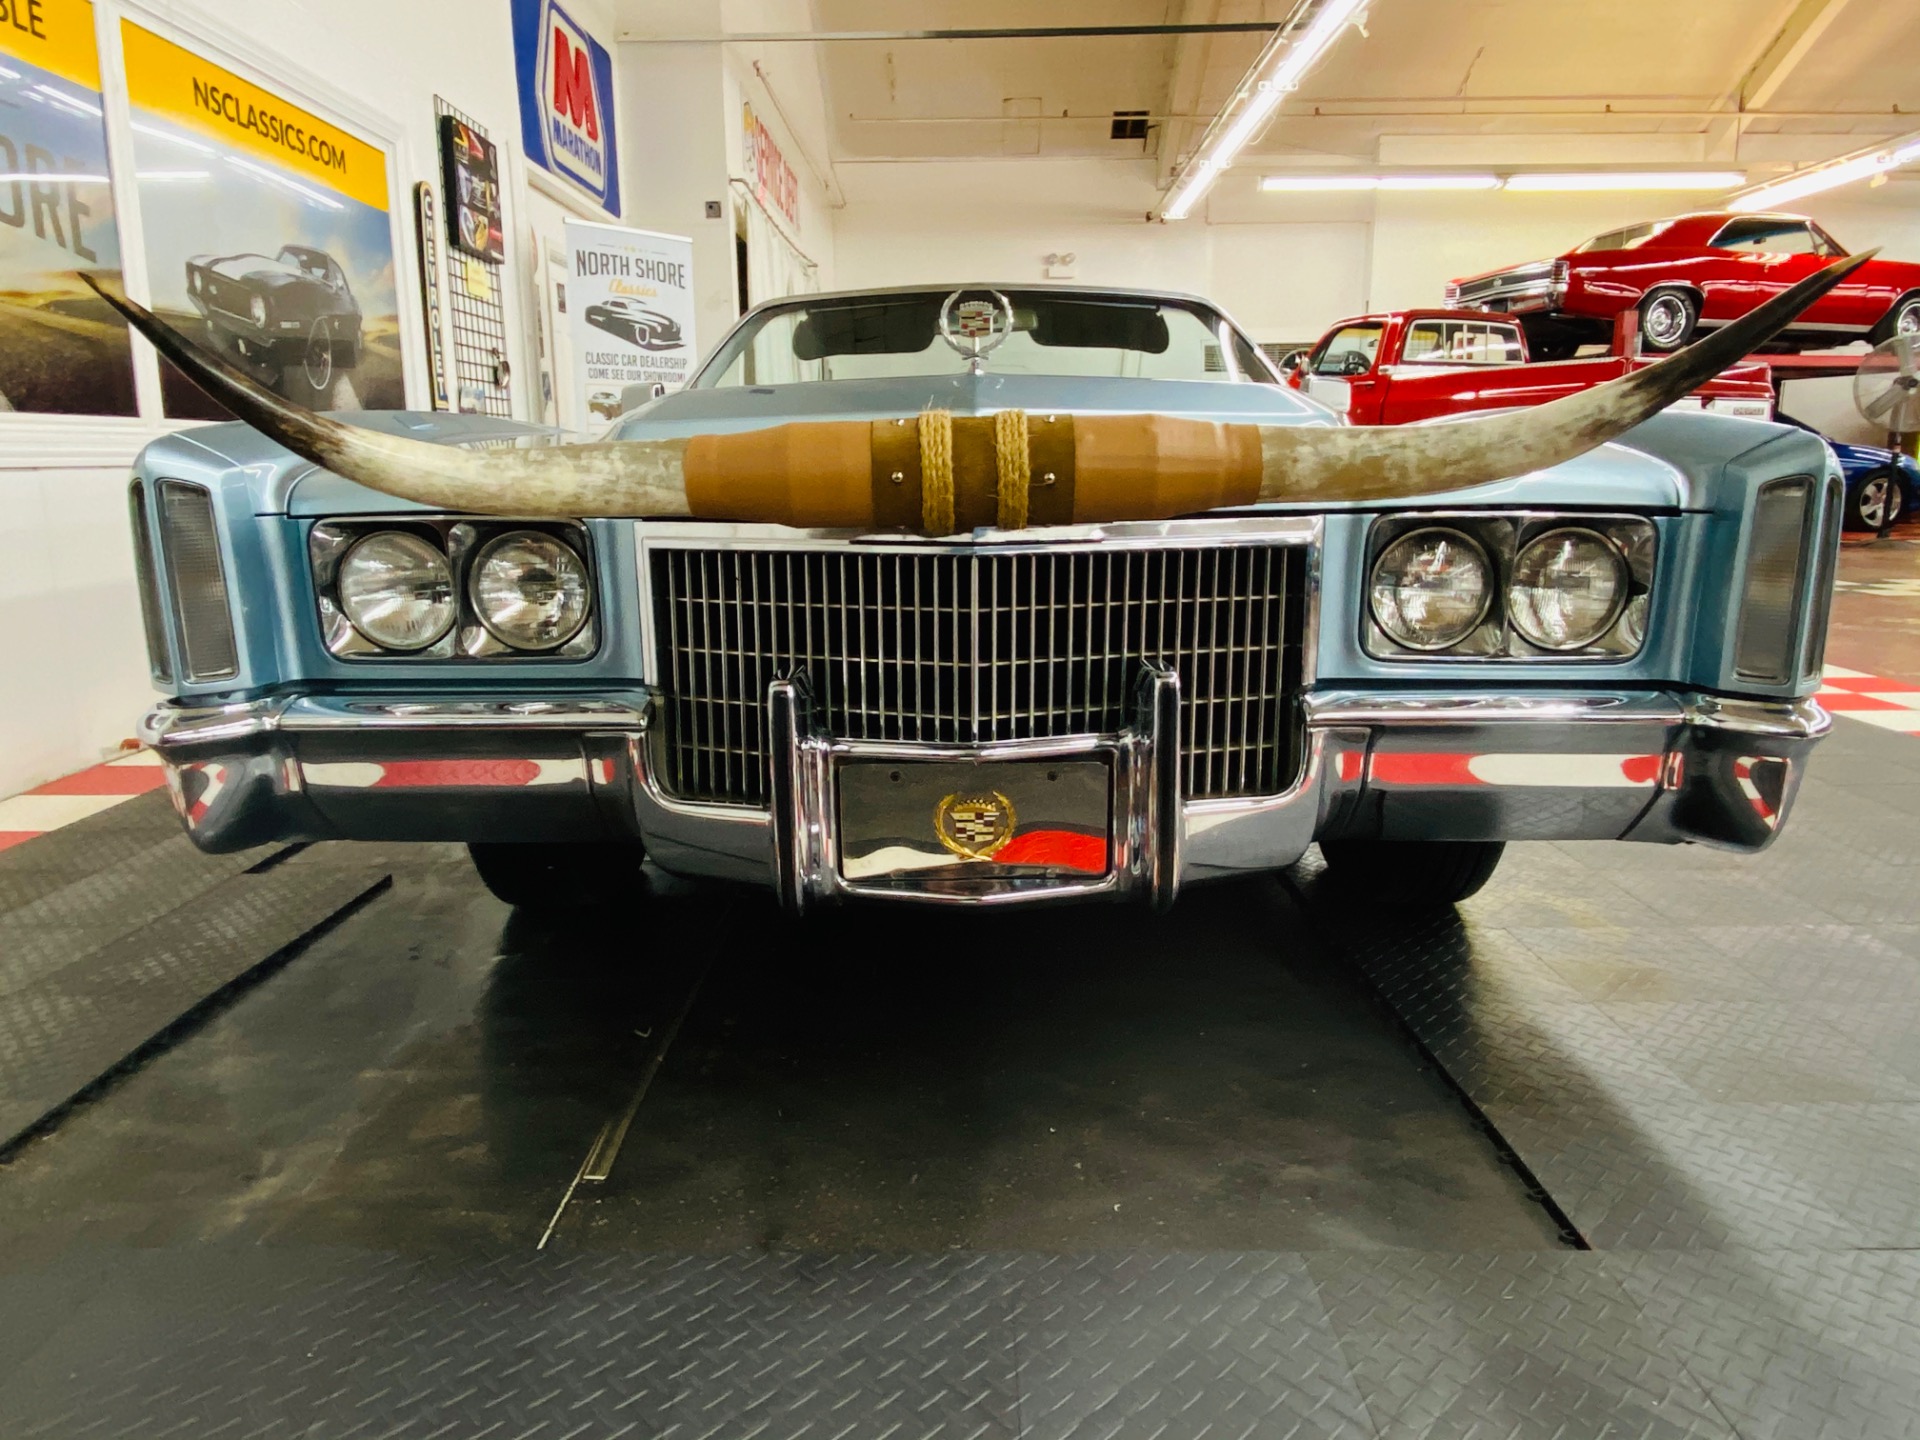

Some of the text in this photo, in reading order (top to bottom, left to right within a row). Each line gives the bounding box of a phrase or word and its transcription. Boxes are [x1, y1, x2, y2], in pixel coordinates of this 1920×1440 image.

[554, 26, 598, 143] M
[192, 76, 346, 174] NSCLASSICS.COM
[553, 116, 602, 177] MARATHON
[424, 194, 447, 400] CHEVROLET
[576, 249, 686, 290] NORTH SHORE
[585, 351, 687, 370] CLASSIC CAR DEALERSHIP
[588, 367, 610, 380] COME
[611, 368, 625, 381] SEE
[626, 369, 642, 381] OUR
